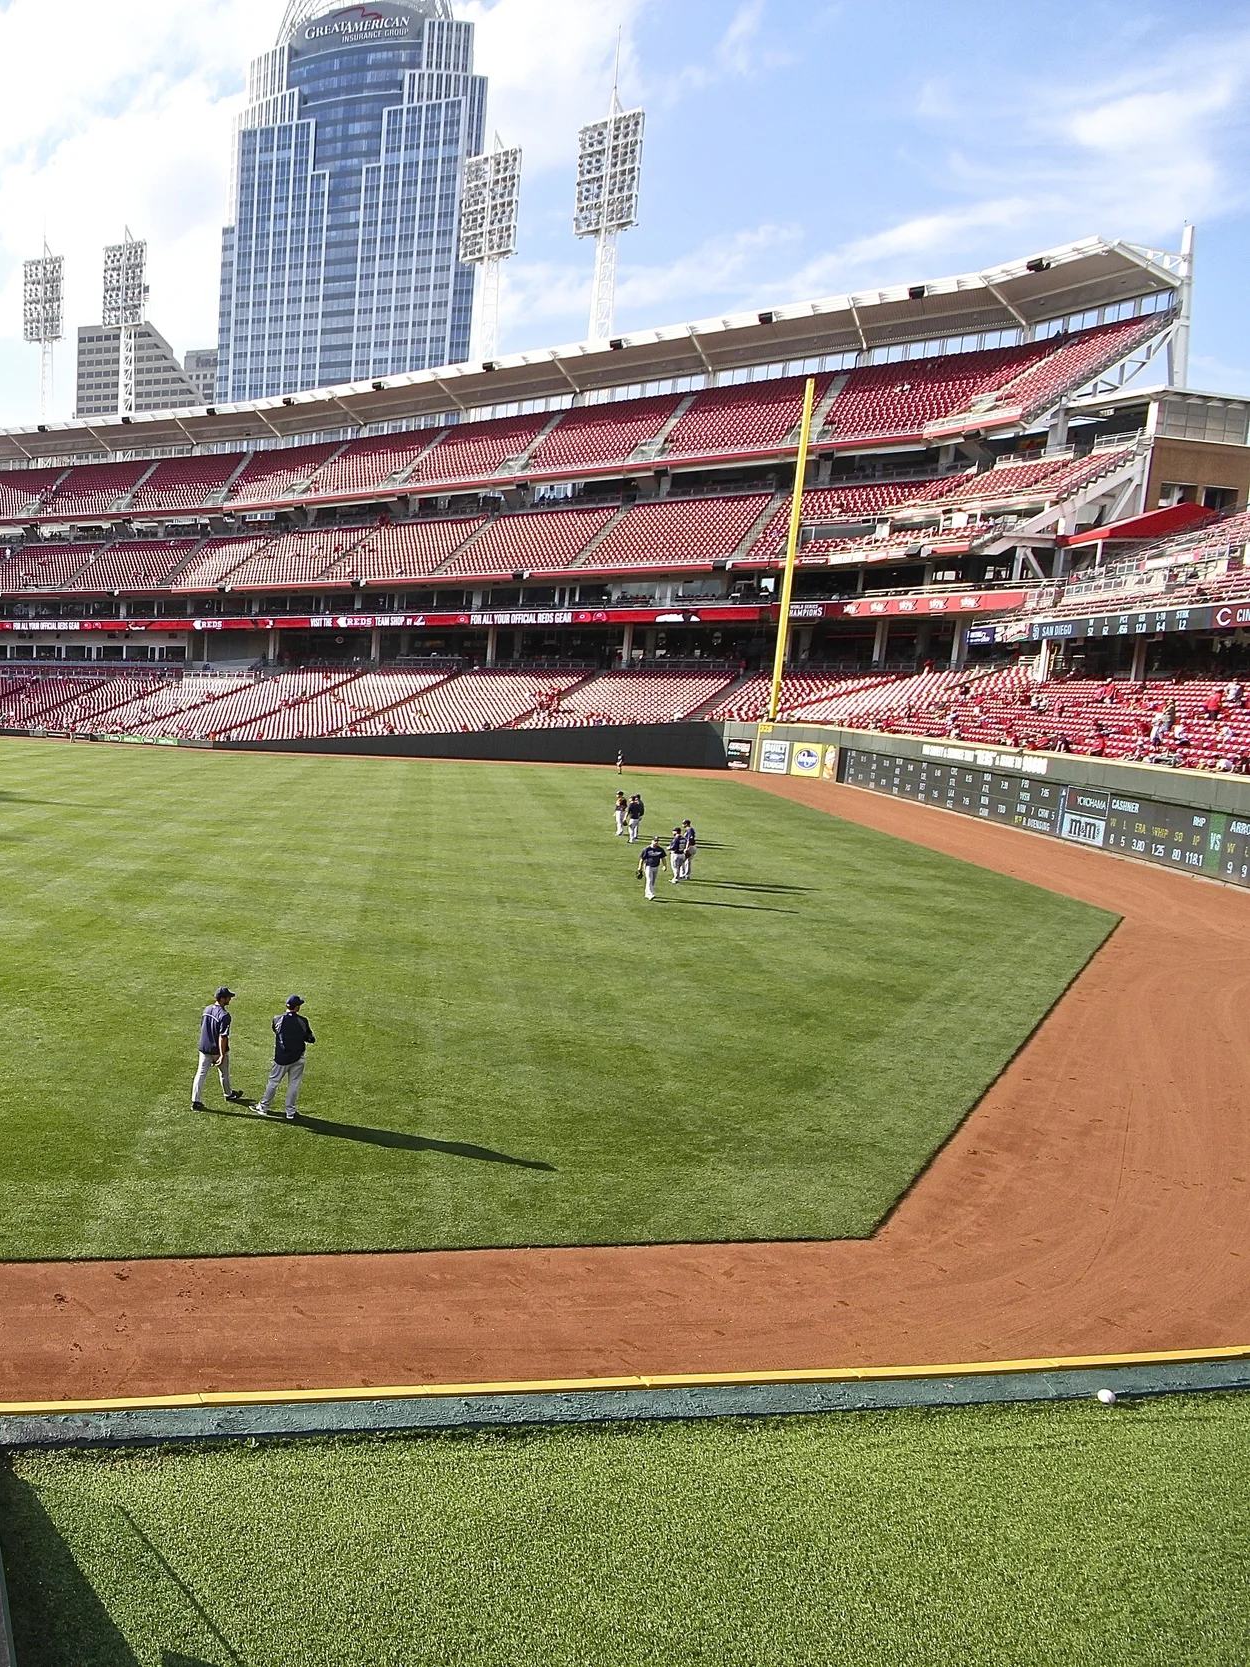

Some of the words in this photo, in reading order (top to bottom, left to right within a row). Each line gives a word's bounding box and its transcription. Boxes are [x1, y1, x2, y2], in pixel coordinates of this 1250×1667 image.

[342, 16, 410, 34] AMERICAN
[341, 30, 382, 43] INSURANCE
[384, 28, 409, 37] GROUP
[470, 614, 482, 624] FOR
[482, 614, 493, 624] ALL
[494, 613, 510, 624] YOUR
[510, 613, 537, 624] OFFICIAL
[537, 612, 554, 623] REDS
[554, 612, 572, 623] GEAR
[788, 607, 823, 617] HAMPIONS
[1119, 615, 1128, 624] PCT
[1176, 610, 1190, 619] STRK
[20, 622, 28, 631] ALL
[29, 622, 39, 631] YOUR
[40, 621, 57, 630] OFFICIAL
[69, 621, 80, 630] GEAR
[201, 621, 222, 629] REDS
[310, 618, 323, 627] VISIT
[323, 618, 333, 627] THE
[347, 617, 372, 626] REDS
[375, 616, 390, 626] TEAM
[390, 616, 404, 626] SHOP
[1042, 625, 1054, 637] SAN
[1054, 624, 1072, 636] DIEGO
[764, 743, 786, 753] BUILT
[763, 761, 784, 770] TOUGH
[1077, 795, 1106, 810] YOKOHAMA
[1111, 799, 1140, 813] CASHNER
[1051, 811, 1055, 820] 5
[1134, 822, 1146, 834] ERA
[1152, 826, 1169, 839] WHIP
[1109, 834, 1115, 845] 8
[1120, 835, 1126, 847] 5
[1131, 838, 1145, 852] 3.80
[1210, 832, 1221, 851] VS
[1227, 861, 1233, 873] 9
